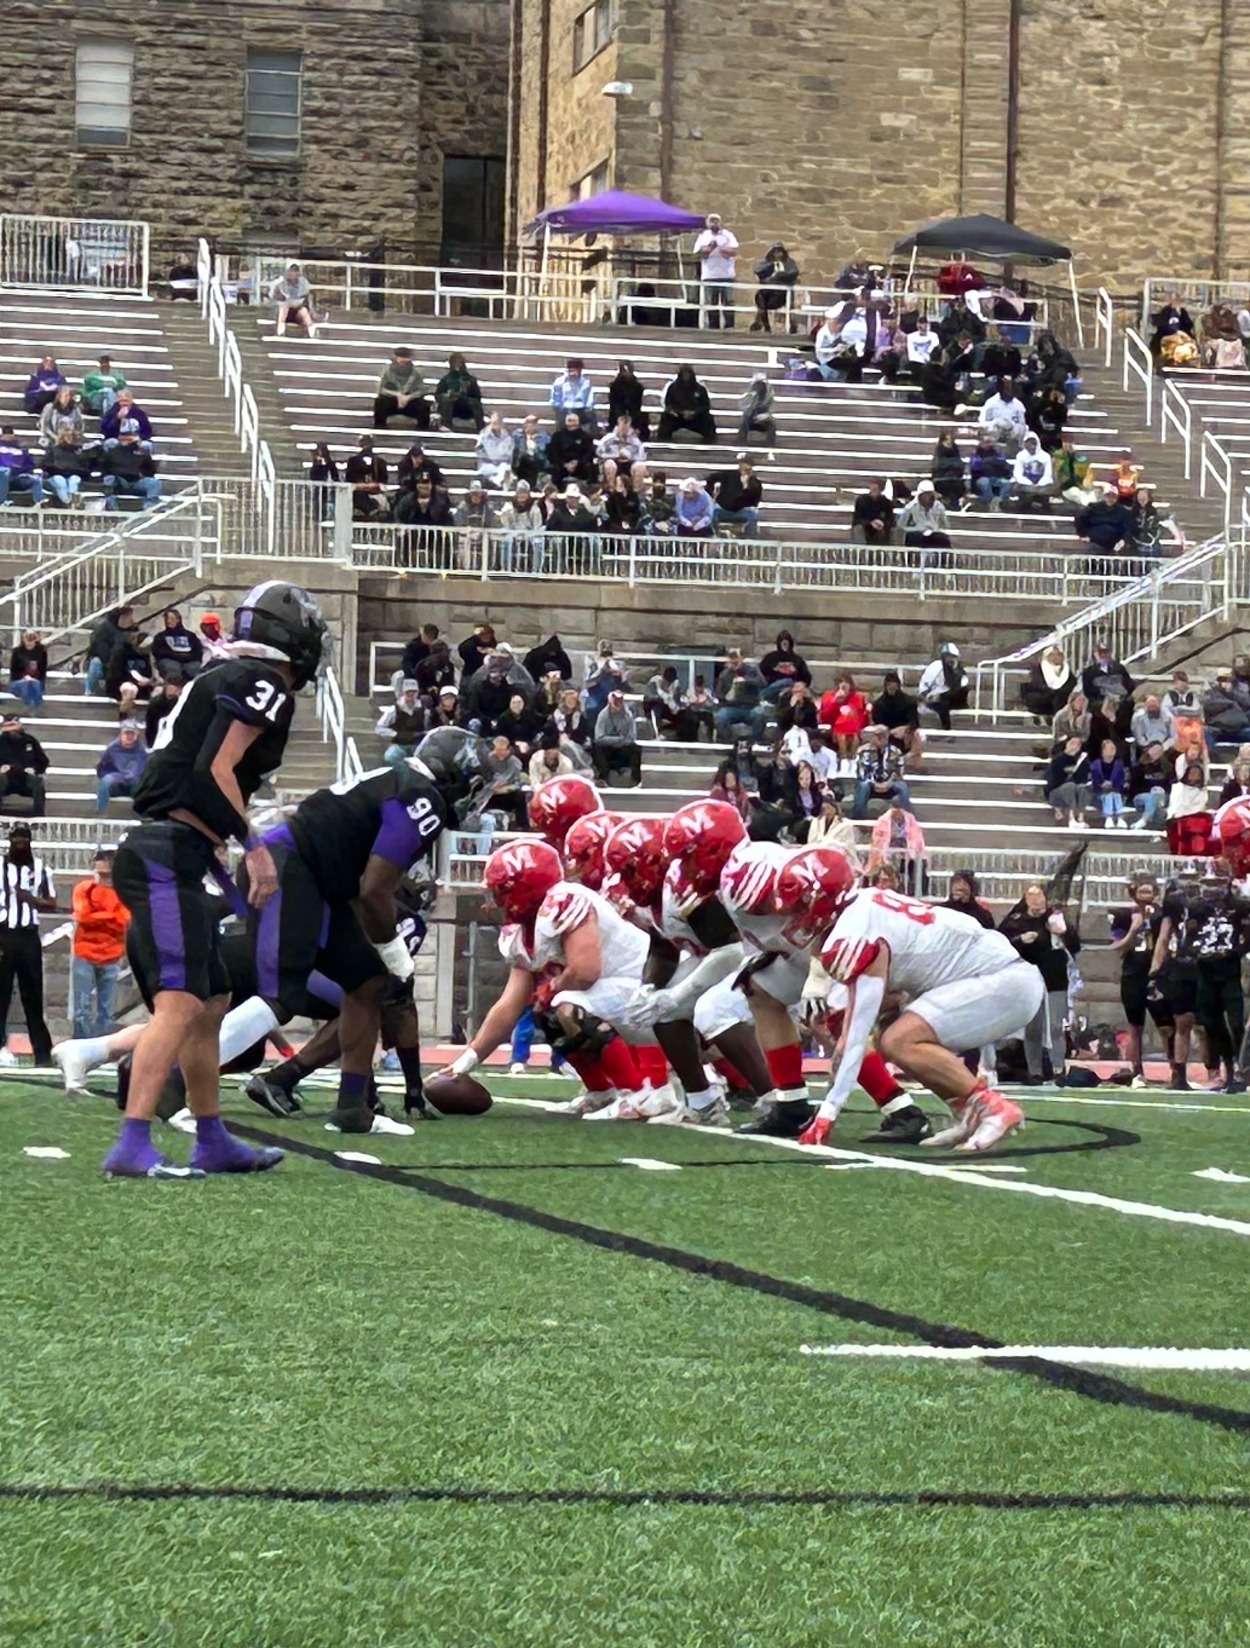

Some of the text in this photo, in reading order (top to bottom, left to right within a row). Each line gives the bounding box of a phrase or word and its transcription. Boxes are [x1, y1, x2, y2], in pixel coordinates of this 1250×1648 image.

[245, 679, 286, 722] 31
[540, 784, 567, 810] M
[406, 797, 440, 837] 90
[679, 808, 715, 838] M
[618, 821, 654, 852] M
[502, 845, 537, 876] M
[790, 852, 829, 884] M
